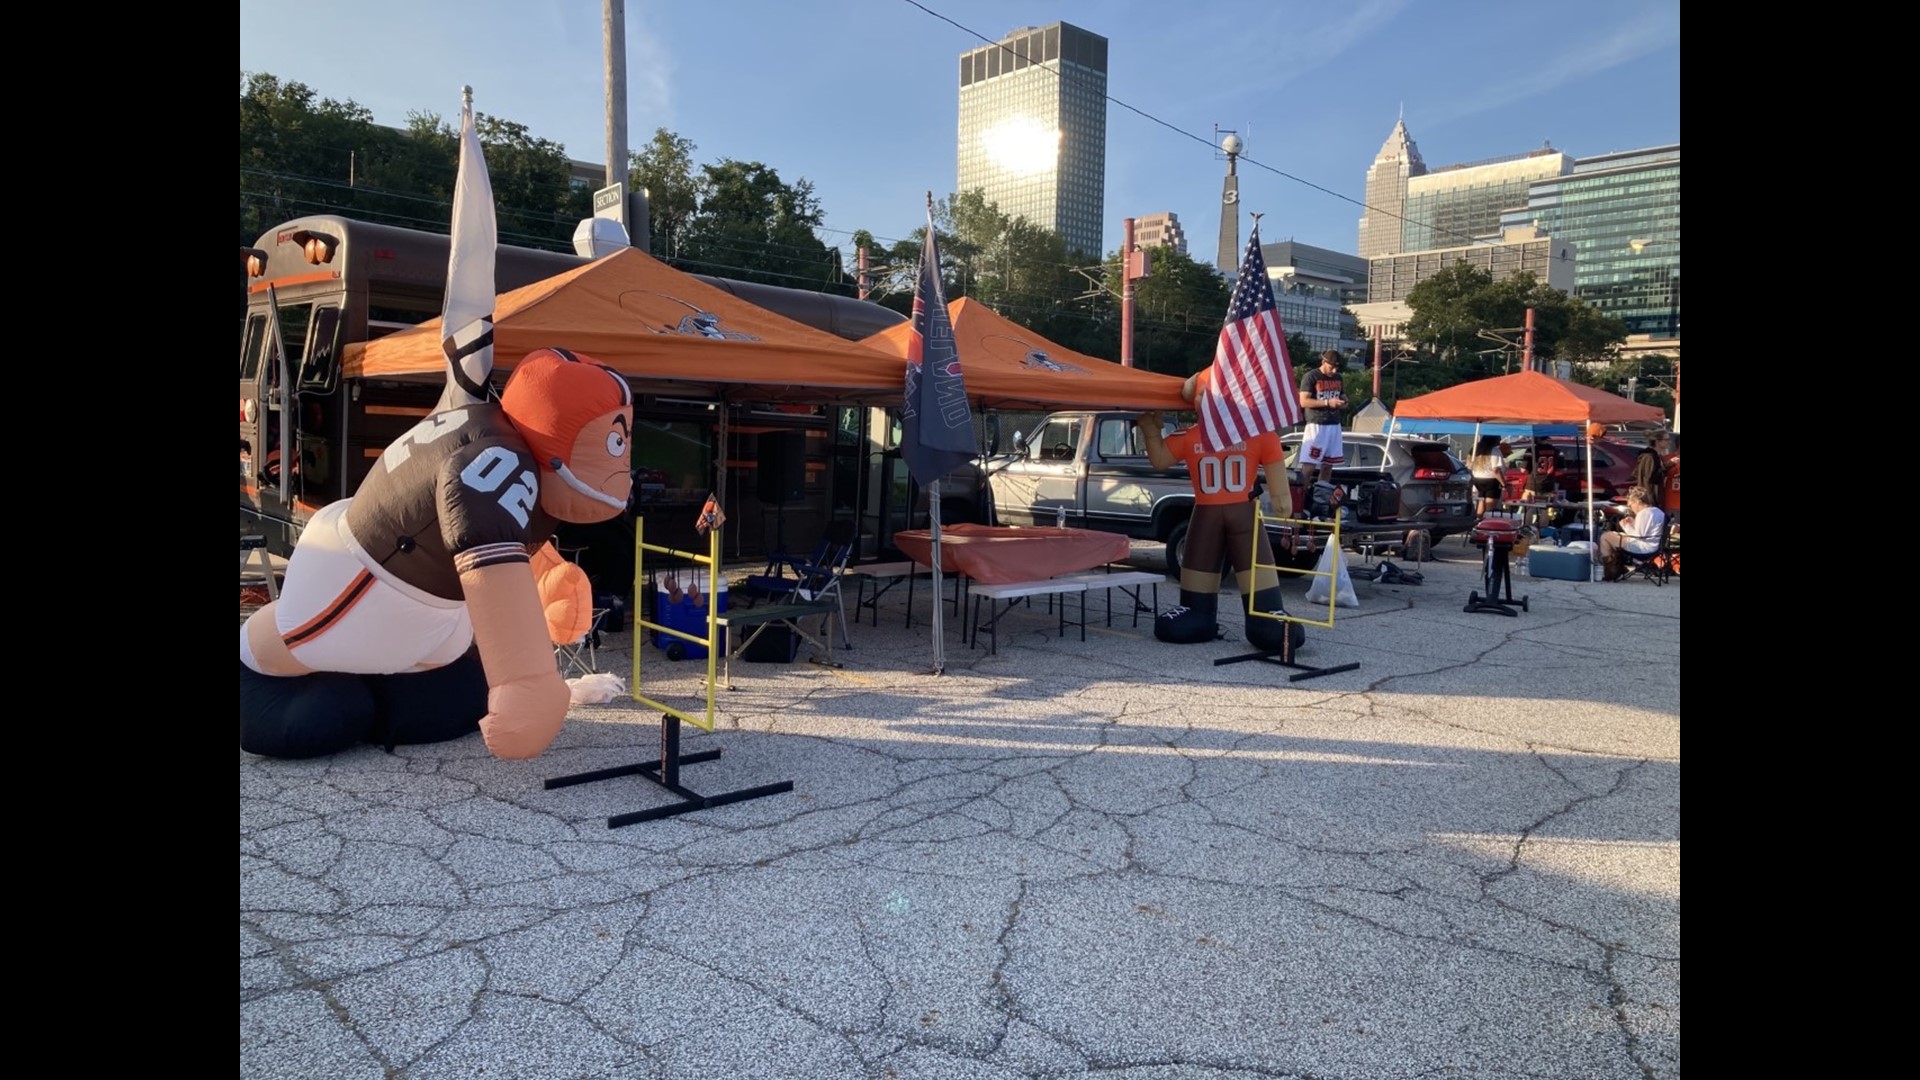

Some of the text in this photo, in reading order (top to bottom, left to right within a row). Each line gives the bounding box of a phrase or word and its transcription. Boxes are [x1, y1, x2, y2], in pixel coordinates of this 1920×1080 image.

[596, 190, 619, 208] SECTION
[1223, 190, 1238, 205] 3
[460, 446, 539, 530] 02
[1198, 454, 1246, 494] 00
